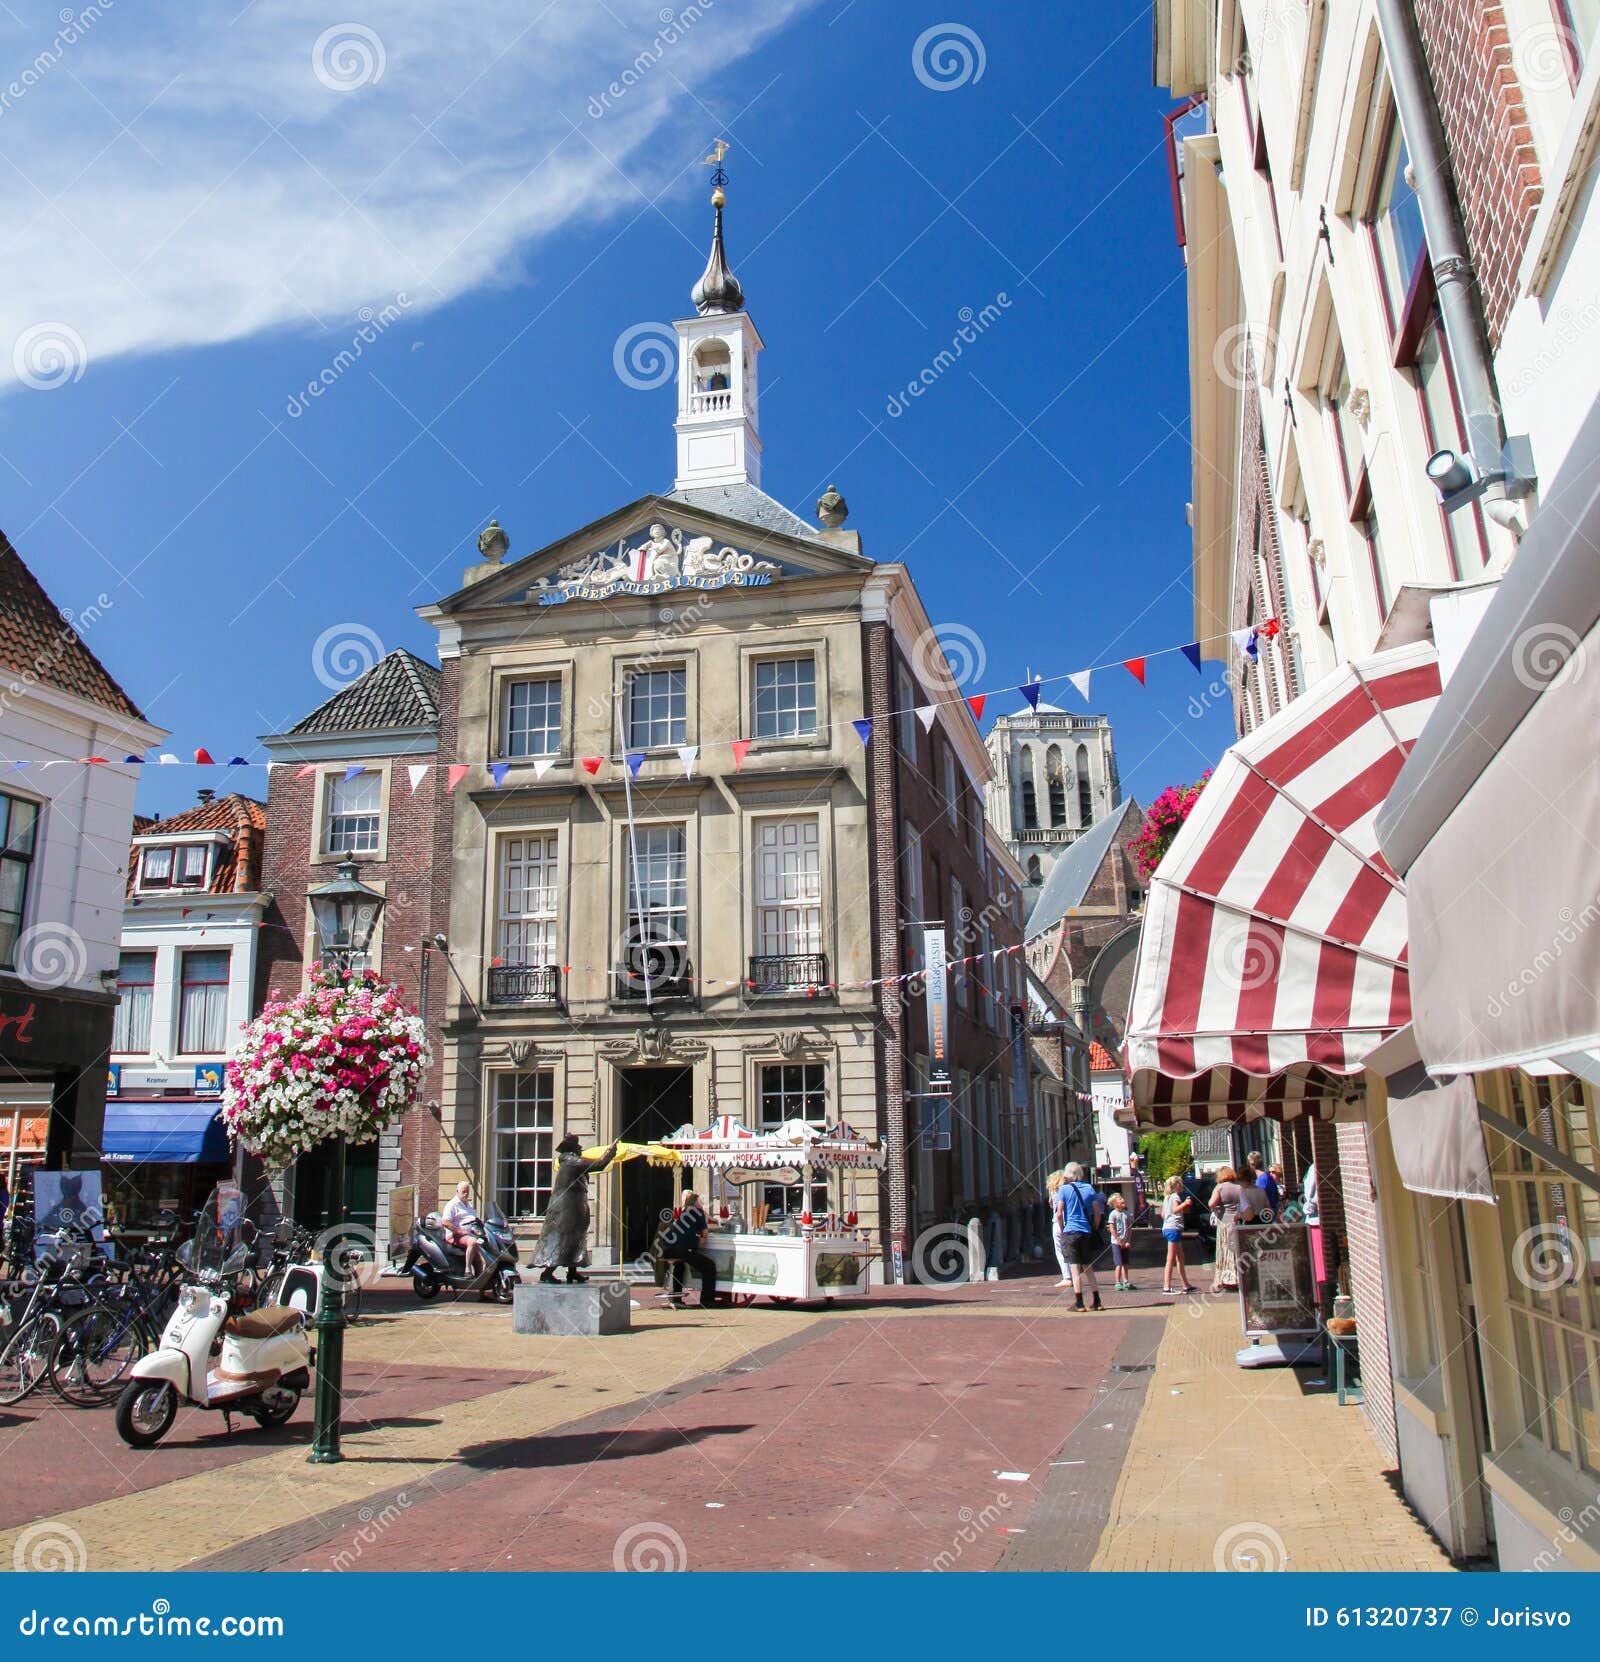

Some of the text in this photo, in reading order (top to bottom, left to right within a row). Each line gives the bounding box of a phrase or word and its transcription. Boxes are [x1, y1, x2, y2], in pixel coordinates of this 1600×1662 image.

[564, 582, 650, 599] LIBERTATIS
[931, 938, 942, 1000] HISTORISCH
[934, 1004, 944, 1059] MUSEUM
[146, 1075, 168, 1083] Kramer
[112, 1152, 135, 1160] Kramer
